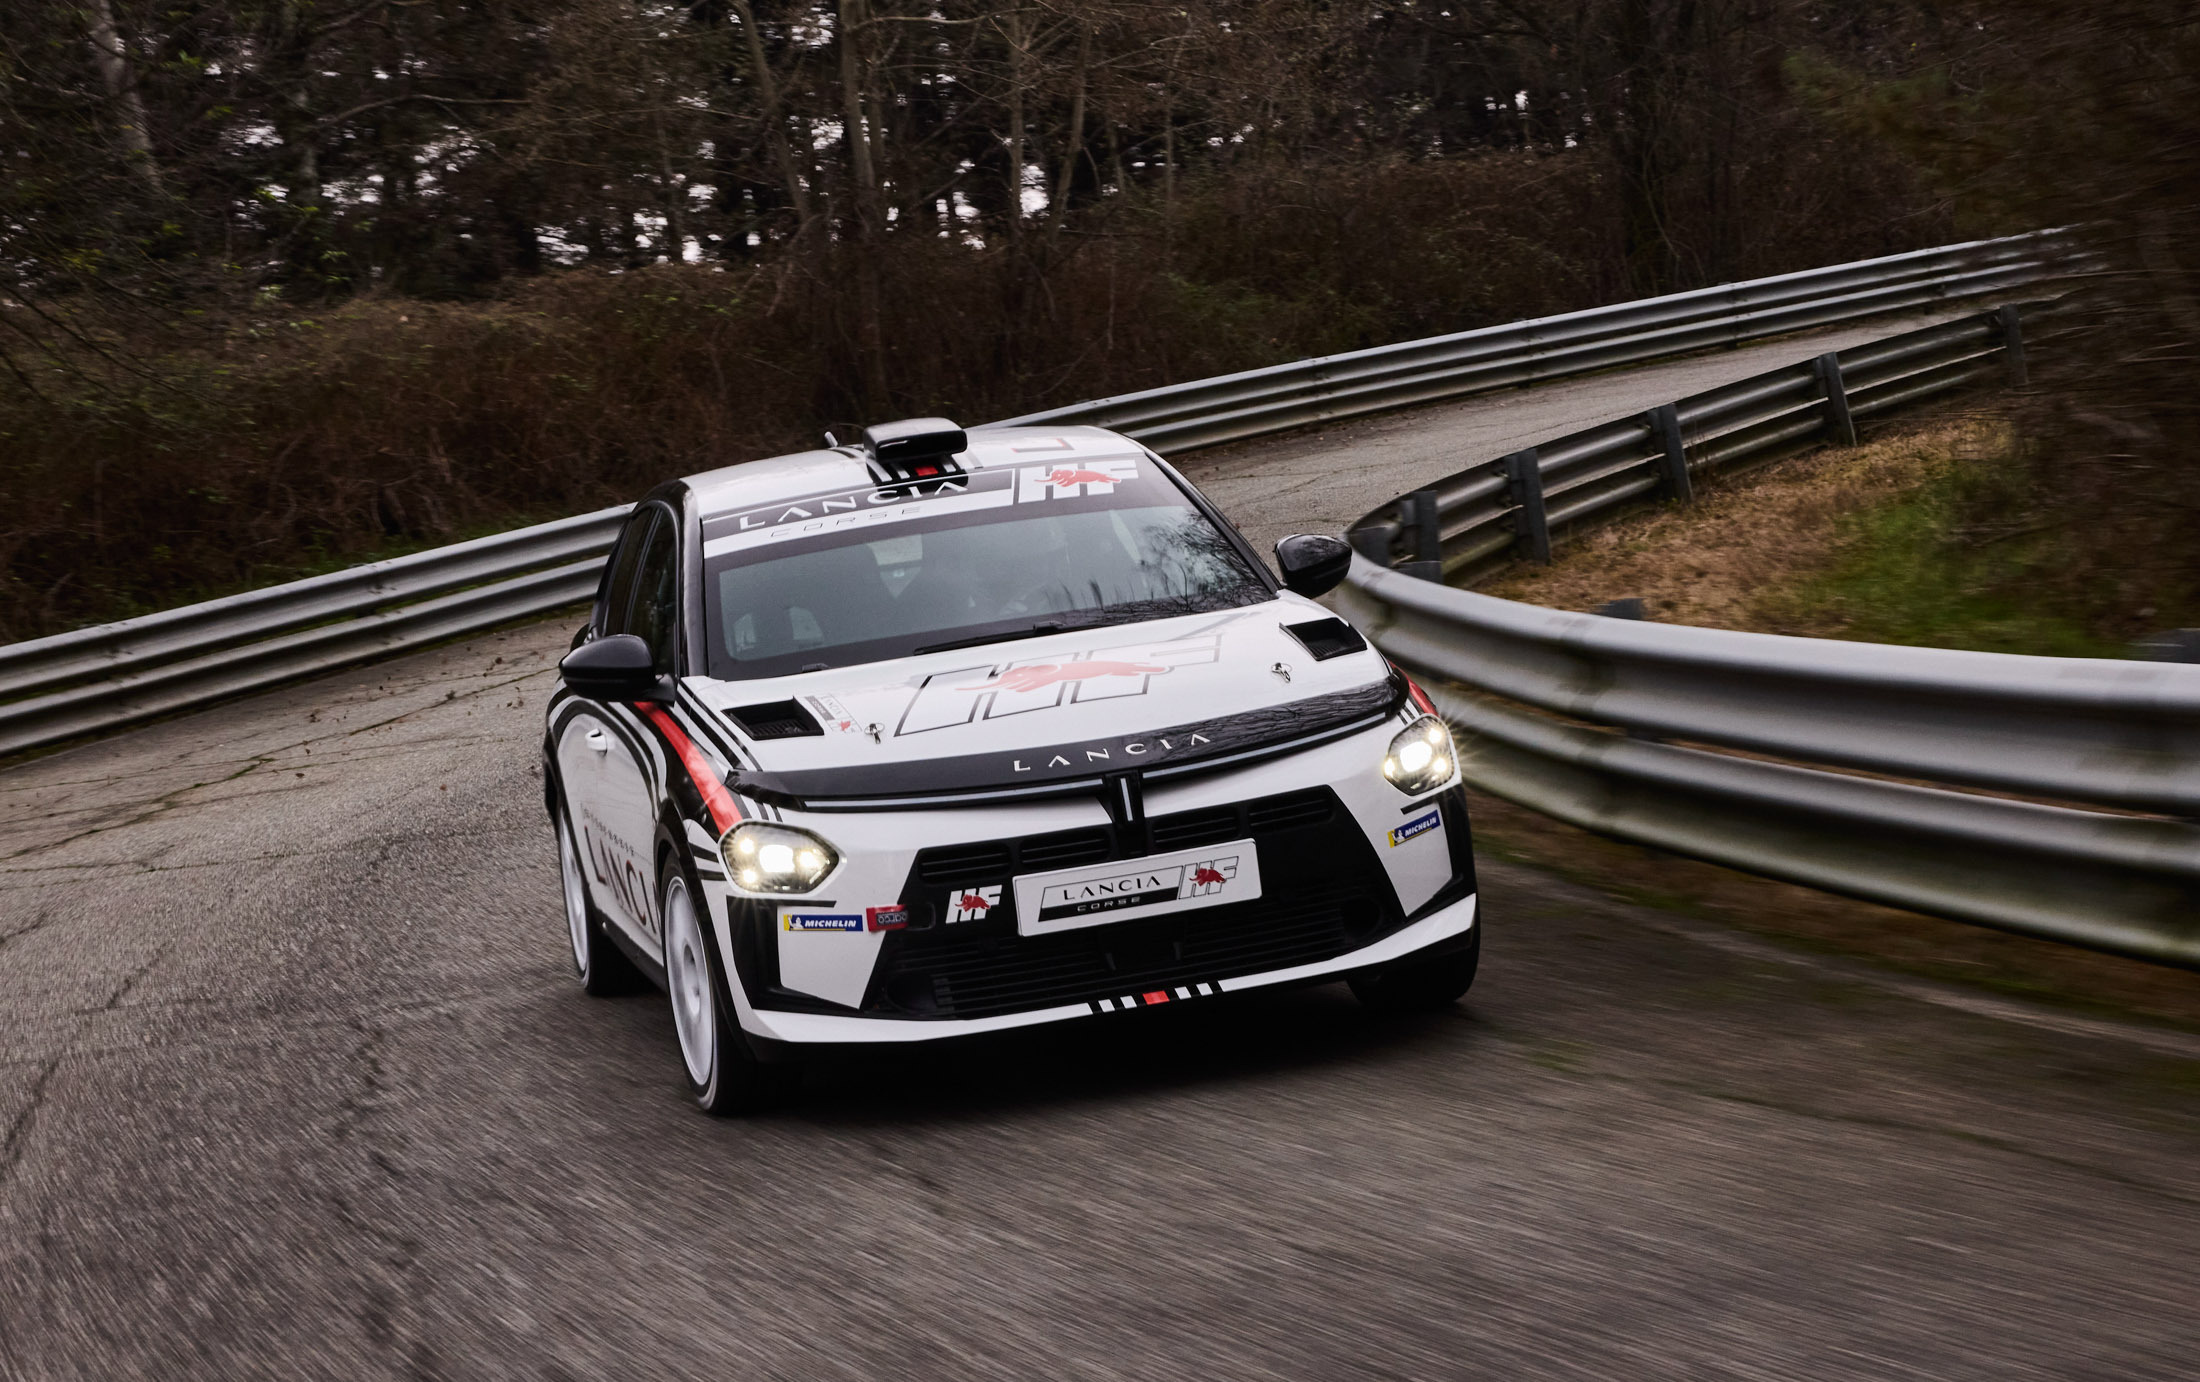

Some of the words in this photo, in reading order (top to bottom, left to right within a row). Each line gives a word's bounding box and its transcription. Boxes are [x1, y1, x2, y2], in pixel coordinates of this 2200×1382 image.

[740, 481, 968, 530] LANCIA
[770, 505, 921, 537] CORSE
[1013, 733, 1211, 772] LANCIA
[1404, 816, 1438, 837] MICHELIN
[1063, 875, 1161, 900] LANCIA
[1077, 896, 1141, 912] CORSE
[804, 919, 857, 928] MICHELIN
